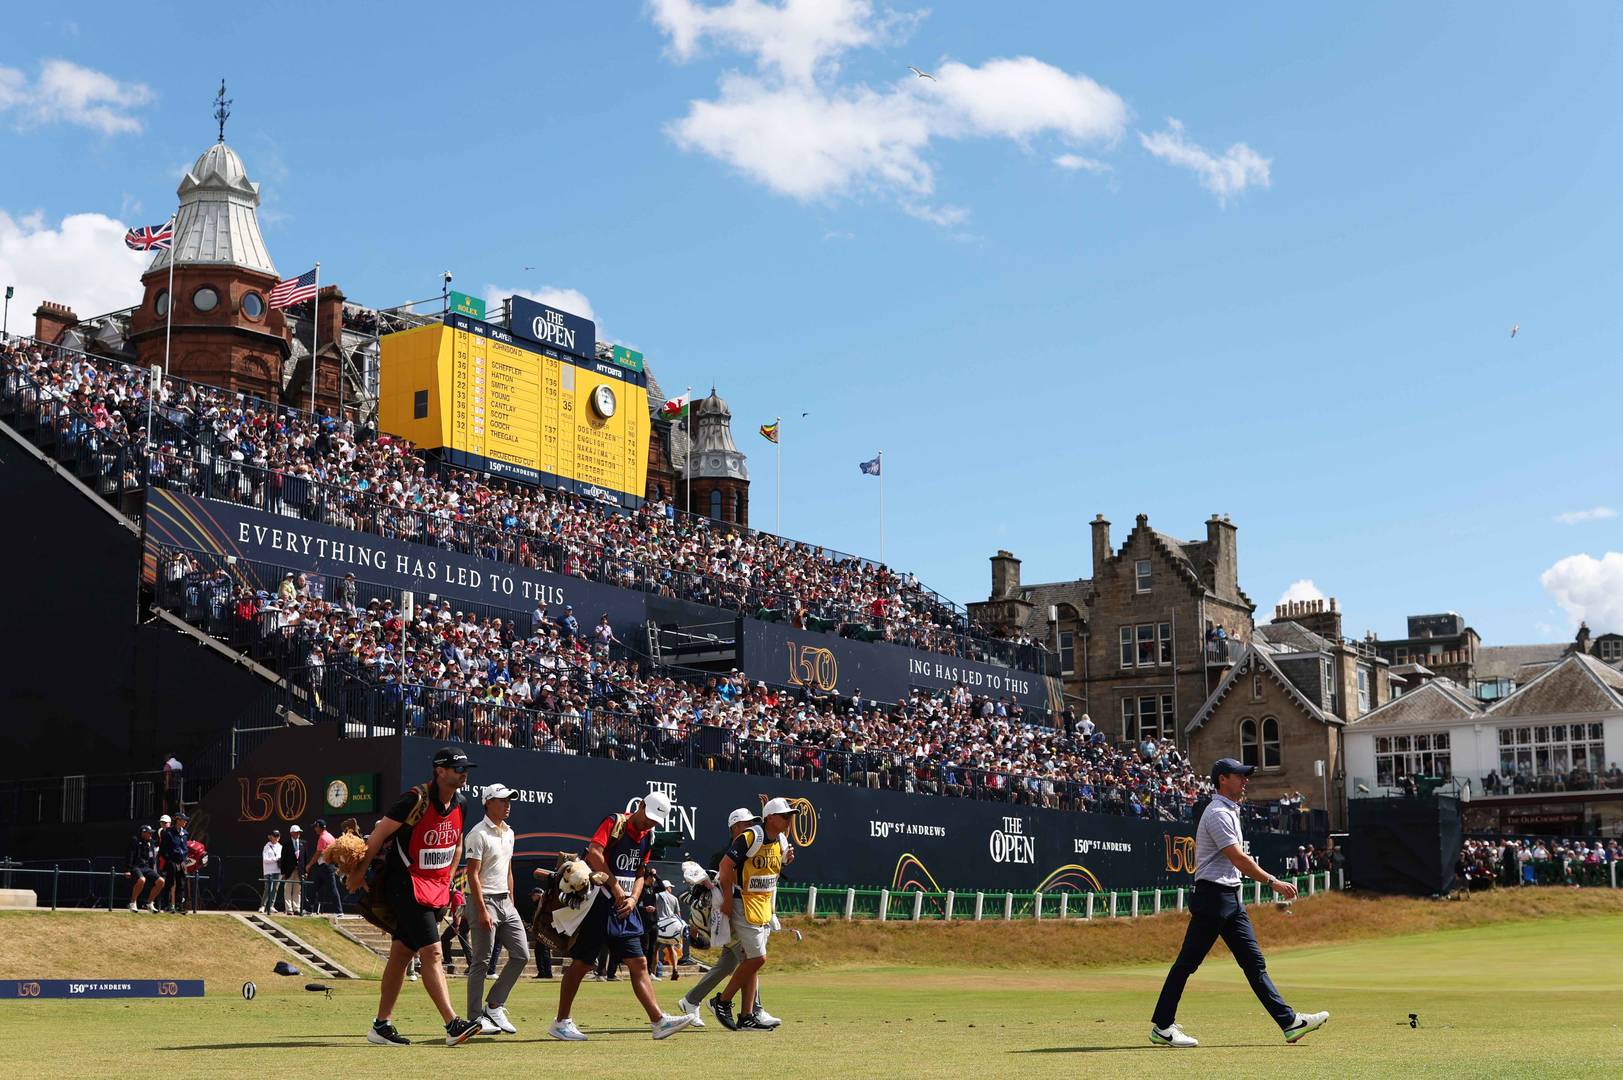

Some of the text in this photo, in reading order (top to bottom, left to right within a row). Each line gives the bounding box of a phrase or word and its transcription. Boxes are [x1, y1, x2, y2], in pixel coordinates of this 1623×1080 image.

[458, 304, 478, 316] ROLEX
[545, 310, 564, 326] THE
[492, 330, 512, 342] PLAYER
[532, 316, 576, 350] OPEN
[492, 342, 517, 355] JOHNSON
[491, 360, 523, 376] SCHEFFLER
[596, 364, 608, 374] NTT
[492, 370, 513, 382] HATTON
[457, 381, 466, 389] 22
[491, 390, 510, 402] YOUNG
[491, 380, 508, 391] SMITH
[457, 391, 466, 399] 33
[491, 400, 516, 412] CANTLAY
[563, 400, 572, 411] 35
[491, 410, 509, 420] SCOTT
[490, 420, 510, 430] GOOCH
[490, 430, 519, 443] THEEGALA
[578, 434, 604, 448] ENGLISH
[489, 449, 523, 464] PROJECTED
[512, 467, 539, 478] ANDREWS
[238, 522, 564, 605] EVERYTHING HAS LED TO THIS
[786, 640, 838, 692] 150
[909, 659, 1028, 695] ING HAS LED TO THIS
[238, 774, 307, 822] 150
[520, 790, 554, 804] REWS
[646, 780, 678, 803] THE
[438, 820, 452, 831] THE
[895, 822, 905, 833] ST
[906, 824, 946, 837] ANDREWS
[1002, 816, 1023, 834] THE
[423, 828, 461, 846] OPEN
[989, 829, 1036, 864] OPEN
[1093, 840, 1100, 850] ST
[1102, 842, 1131, 852] ANDREWS
[1164, 832, 1197, 875] 150
[752, 855, 781, 869] OPEN
[17, 982, 40, 996] 150
